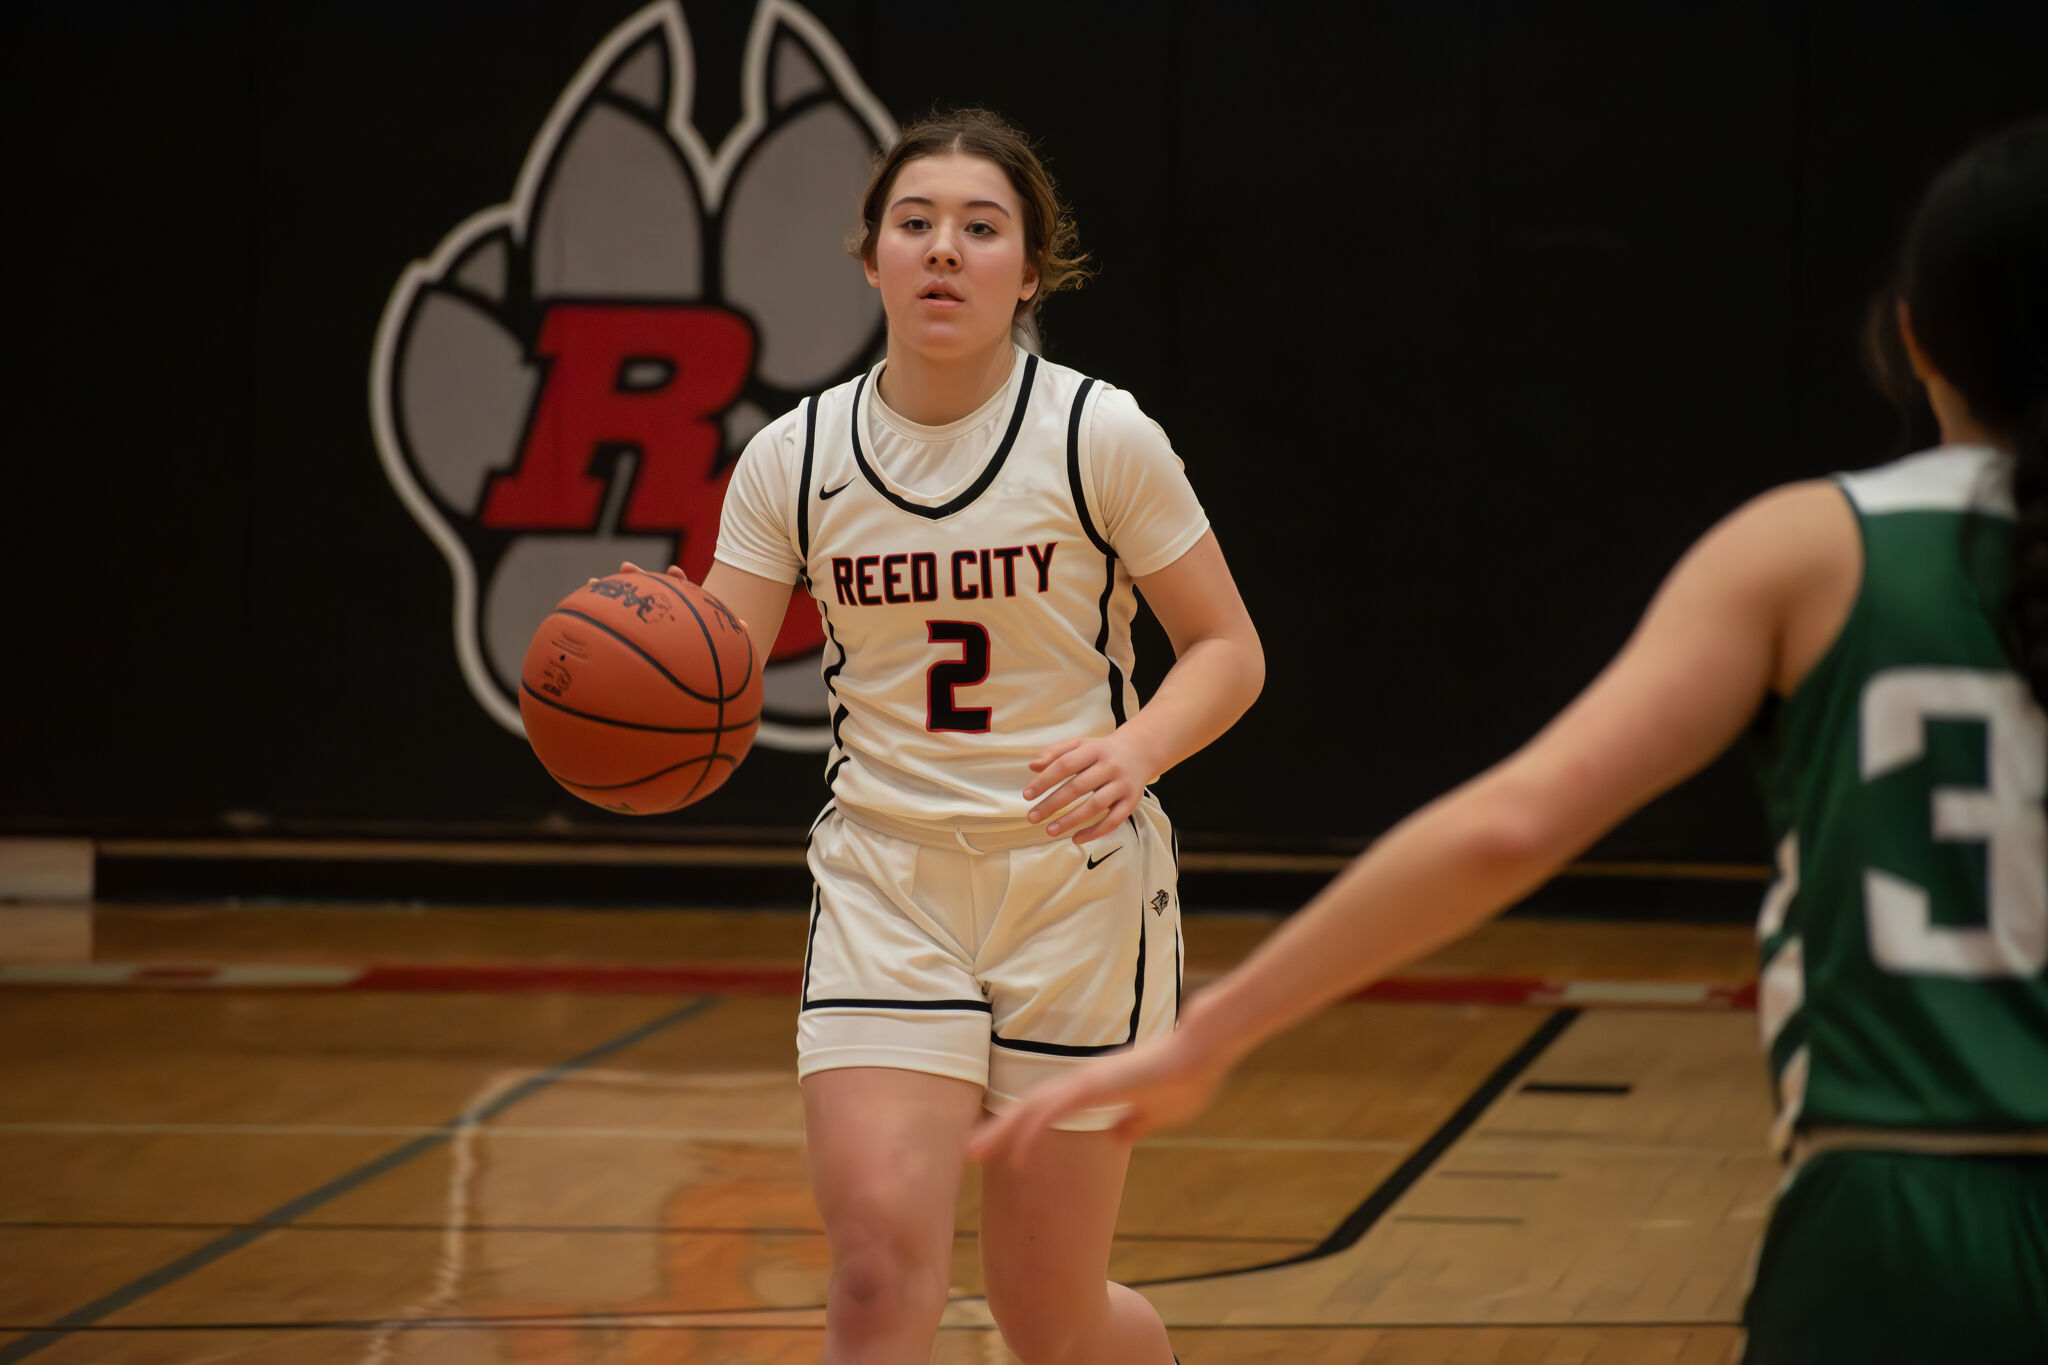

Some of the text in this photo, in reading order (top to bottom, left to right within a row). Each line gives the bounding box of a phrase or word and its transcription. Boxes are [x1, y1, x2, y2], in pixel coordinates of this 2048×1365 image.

[832, 541, 1059, 607] REED CITY
[925, 620, 992, 734] 2
[1858, 665, 2047, 980] 3
